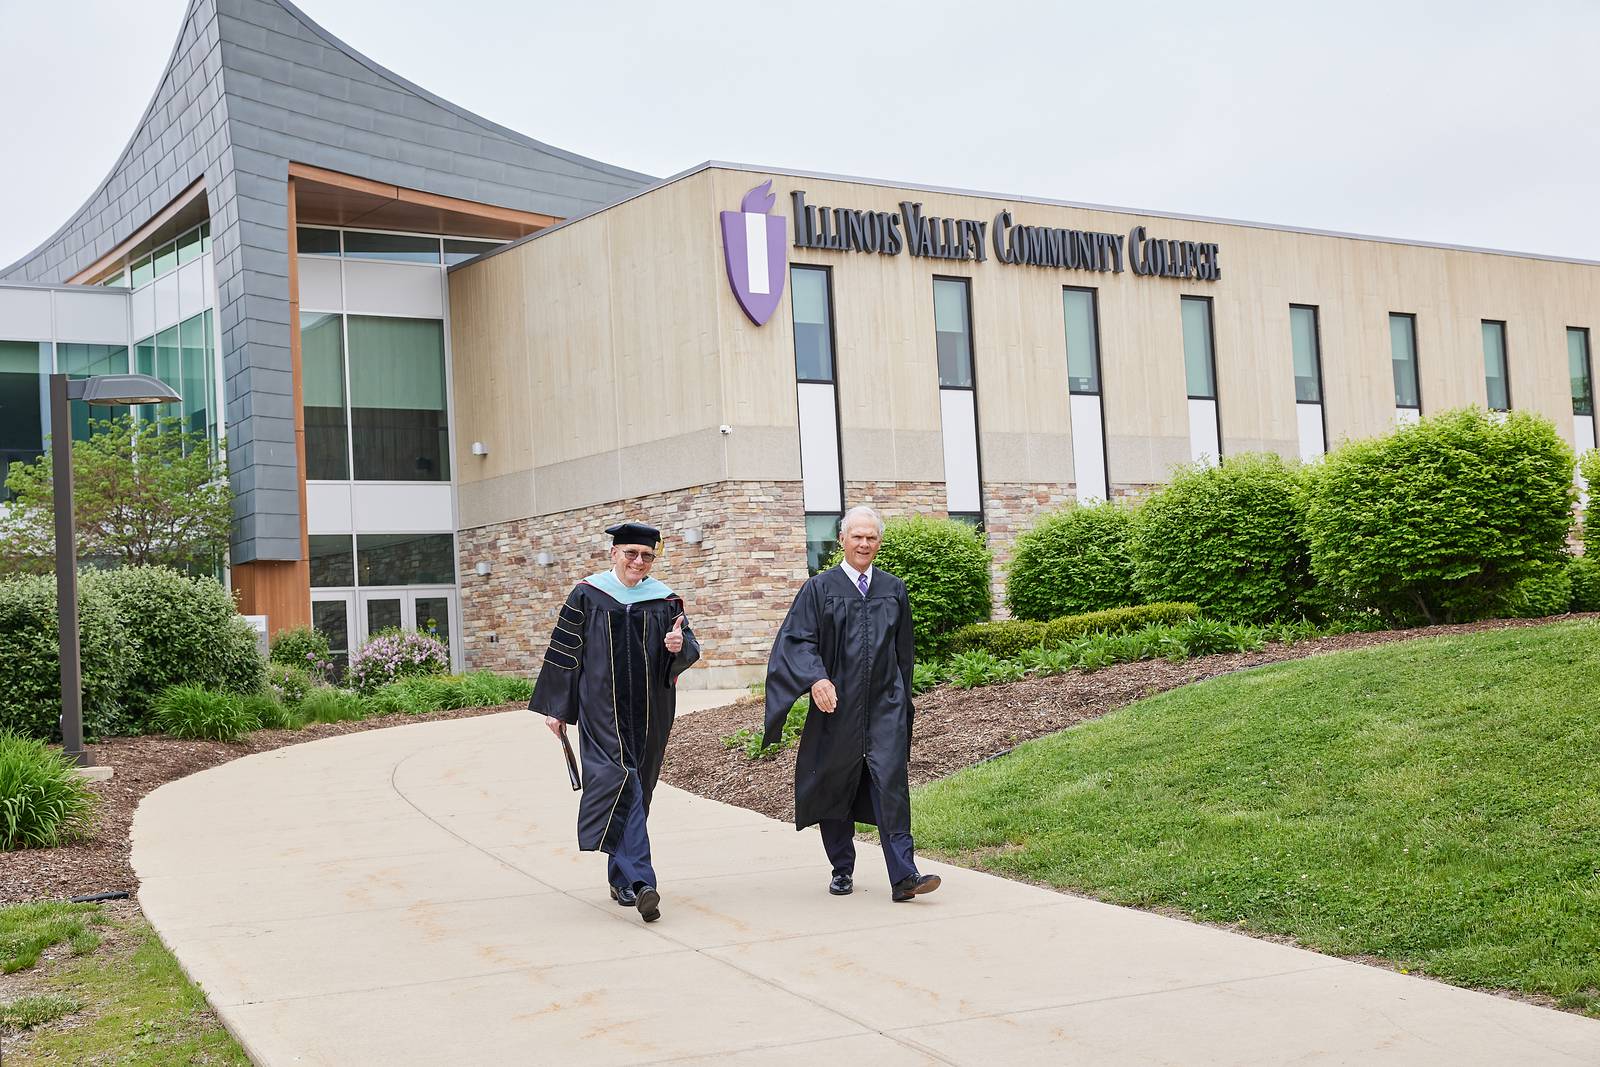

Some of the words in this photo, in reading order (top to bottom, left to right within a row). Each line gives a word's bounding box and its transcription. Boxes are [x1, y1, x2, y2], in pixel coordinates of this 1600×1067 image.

[790, 190, 903, 256] ILLINOIS
[899, 201, 987, 262] VALLEY
[992, 211, 1125, 273] COMMUNITY
[1129, 226, 1221, 281] COLLEGE
